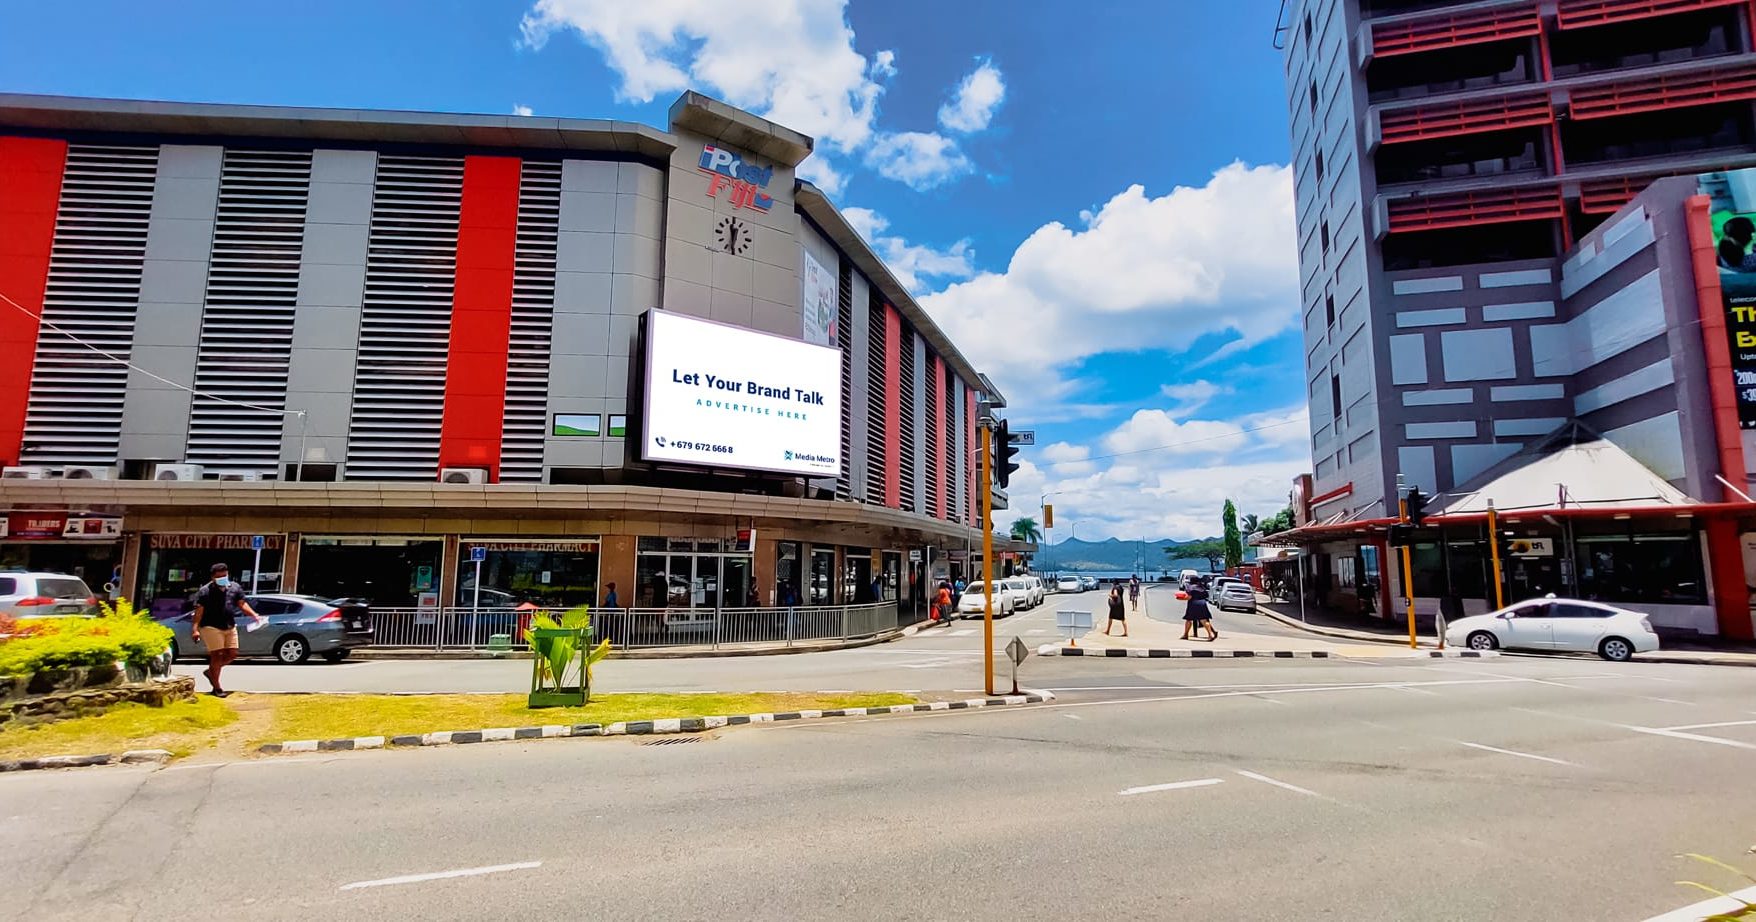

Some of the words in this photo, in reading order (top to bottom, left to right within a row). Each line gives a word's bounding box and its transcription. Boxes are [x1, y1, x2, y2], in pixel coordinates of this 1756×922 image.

[705, 174, 758, 209] Fiji
[673, 369, 700, 386] Let
[705, 374, 742, 392] Your
[747, 381, 790, 400] Brand
[795, 389, 824, 406] Talk
[696, 399, 770, 415] ADVERTISE
[777, 410, 807, 421] HERE
[695, 443, 711, 452] 672
[795, 453, 815, 462] Media
[816, 455, 835, 464] Metro
[150, 535, 181, 549] SUVA
[185, 535, 213, 549] CITY
